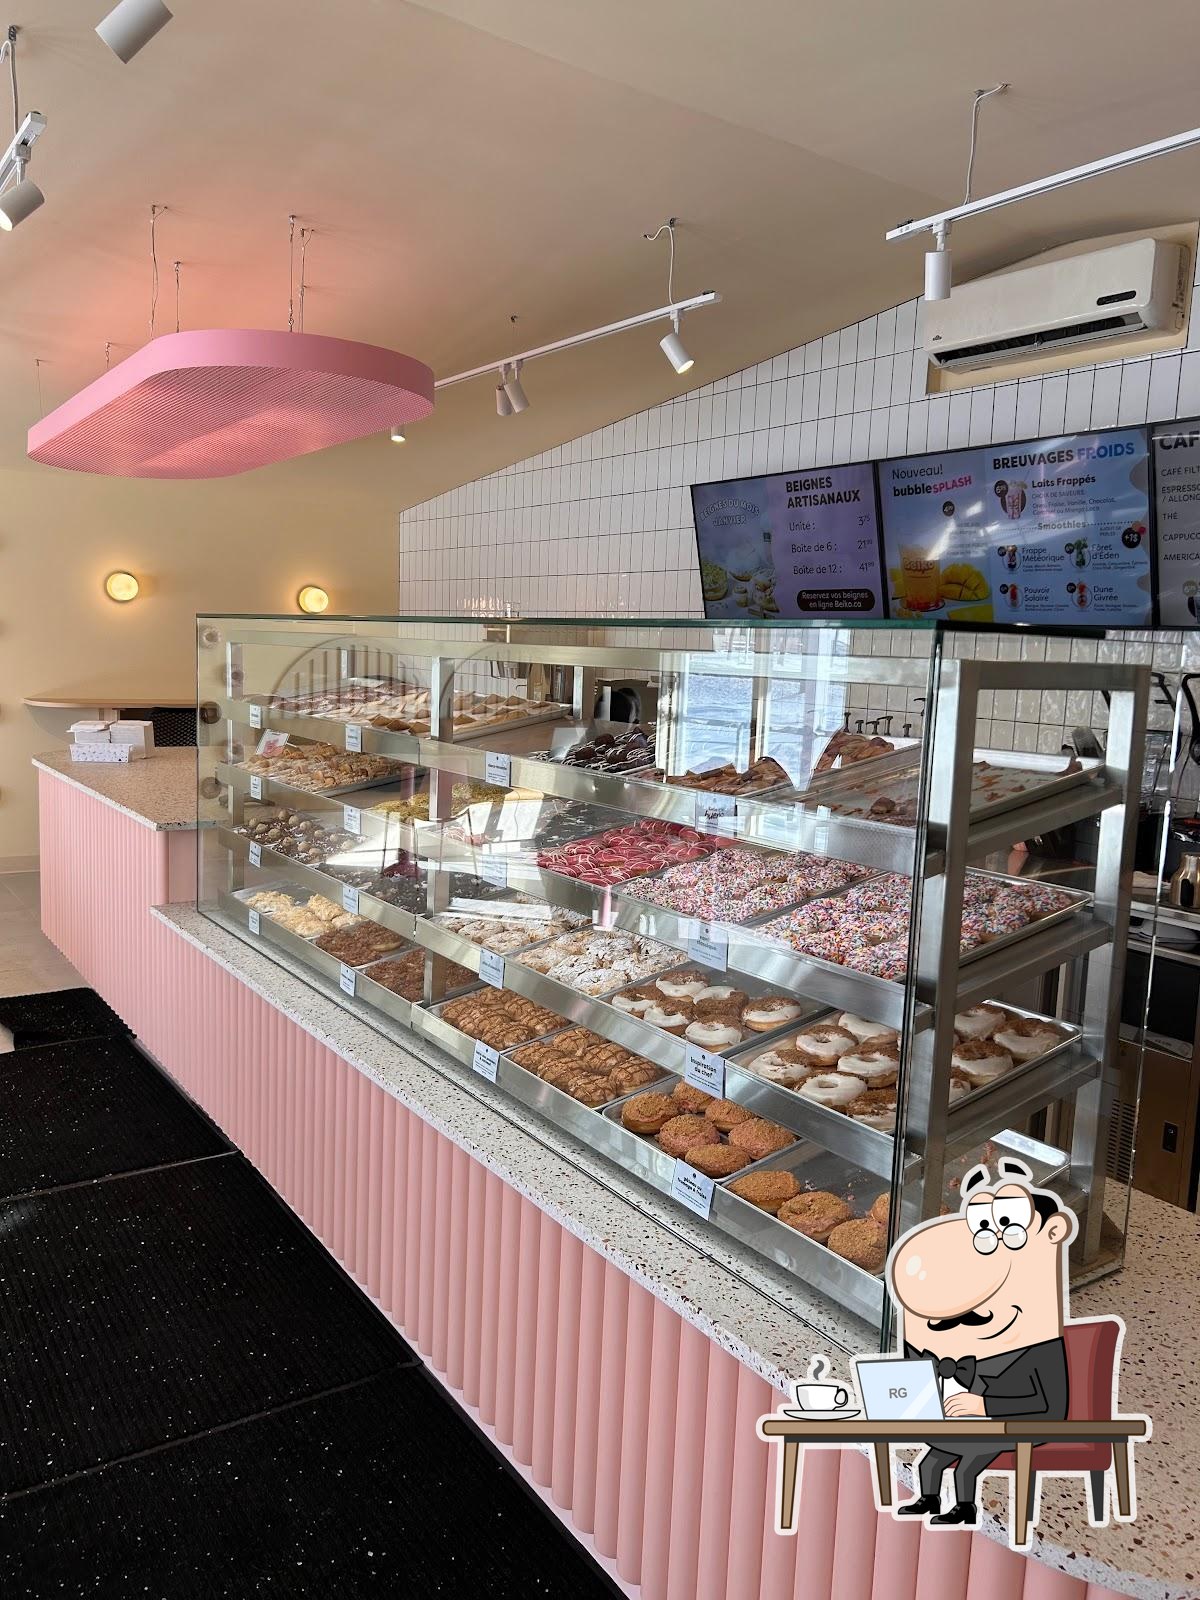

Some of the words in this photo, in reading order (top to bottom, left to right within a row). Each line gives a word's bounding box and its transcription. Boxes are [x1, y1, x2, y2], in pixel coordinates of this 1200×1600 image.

[994, 450, 1074, 470] BREUVAGES
[1078, 442, 1135, 460] FROIDS
[892, 464, 943, 480] Nouveau!
[1161, 467, 1182, 476] CAFÉ
[786, 476, 832, 492] BEIGNES
[1032, 478, 1054, 488] Laits
[1057, 474, 1096, 487] Frappés
[787, 490, 861, 508] ARTISANAUX
[789, 522, 811, 532] Unité
[1038, 520, 1086, 530] Smoothies
[814, 542, 825, 552] de
[826, 541, 832, 551] 6
[816, 563, 827, 574] de
[828, 563, 837, 573] 12
[843, 591, 869, 600] beignes
